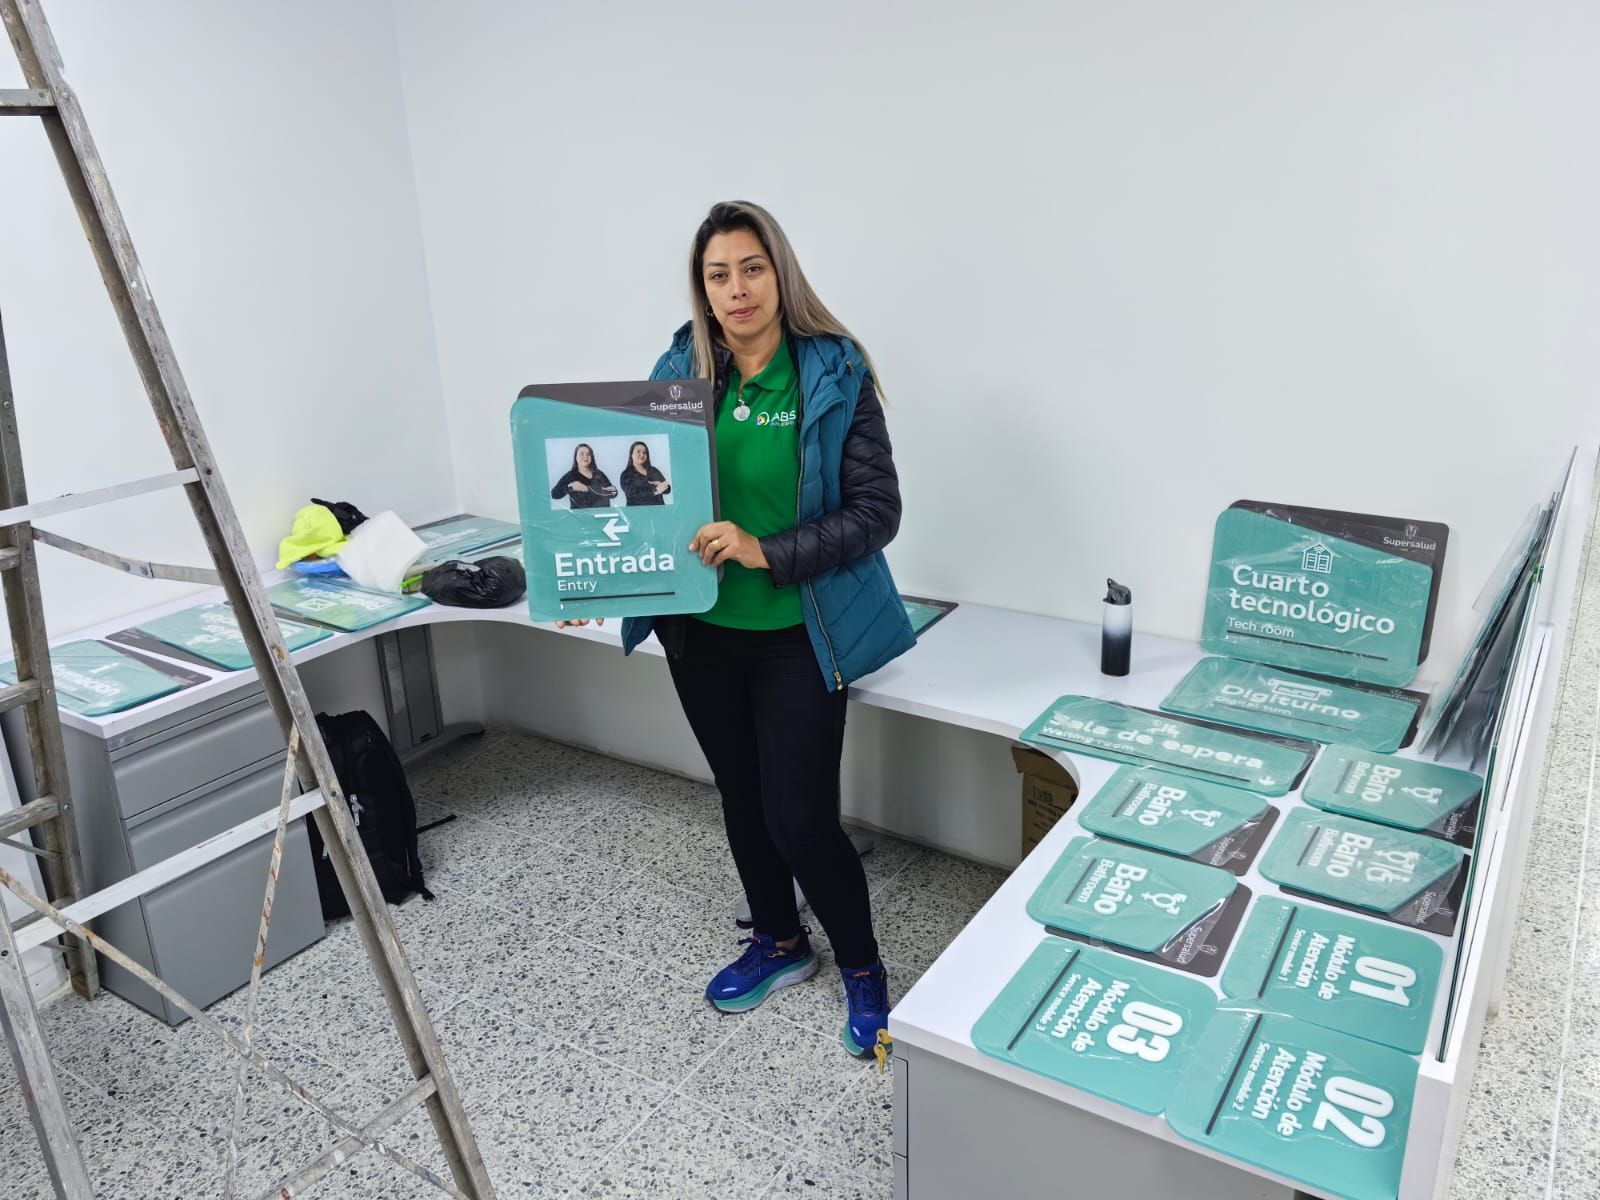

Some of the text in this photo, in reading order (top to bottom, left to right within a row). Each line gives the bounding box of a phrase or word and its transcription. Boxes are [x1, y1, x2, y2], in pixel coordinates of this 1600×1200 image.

[650, 401, 704, 412] Supersalud
[771, 410, 796, 422] ABS
[555, 548, 675, 577] Entrada
[1383, 536, 1437, 551] Supersalud
[558, 580, 598, 592] Entry
[1232, 564, 1330, 598] Cuarto
[1227, 616, 1295, 638] Tech room
[1229, 588, 1395, 634] tecnológico
[1220, 684, 1360, 719] Digiturno
[1043, 725, 1135, 752] Waiting room
[1049, 711, 1264, 769] Sala de espera
[1123, 782, 1154, 817] Bathroom
[1361, 764, 1402, 802] Baño
[1138, 785, 1187, 826] Baño
[1326, 832, 1374, 878] Baño
[1076, 858, 1114, 903] Bathroom
[1094, 862, 1148, 914] Baño
[1177, 927, 1203, 963] Supersalud
[1290, 928, 1306, 952] Service
[1295, 932, 1330, 988] Atención
[1059, 972, 1081, 998] Service
[1317, 934, 1356, 1001] Módulo de
[1349, 956, 1417, 1007] 01
[1040, 997, 1062, 1024] module
[1051, 977, 1103, 1038] Atención
[1071, 980, 1130, 1052] Módulo de
[1106, 1001, 1183, 1062] 03
[1232, 1042, 1270, 1111] Service module 2
[1251, 1047, 1297, 1120] Atención
[1277, 1050, 1327, 1136] Módulo de
[1312, 1076, 1394, 1148] 02
